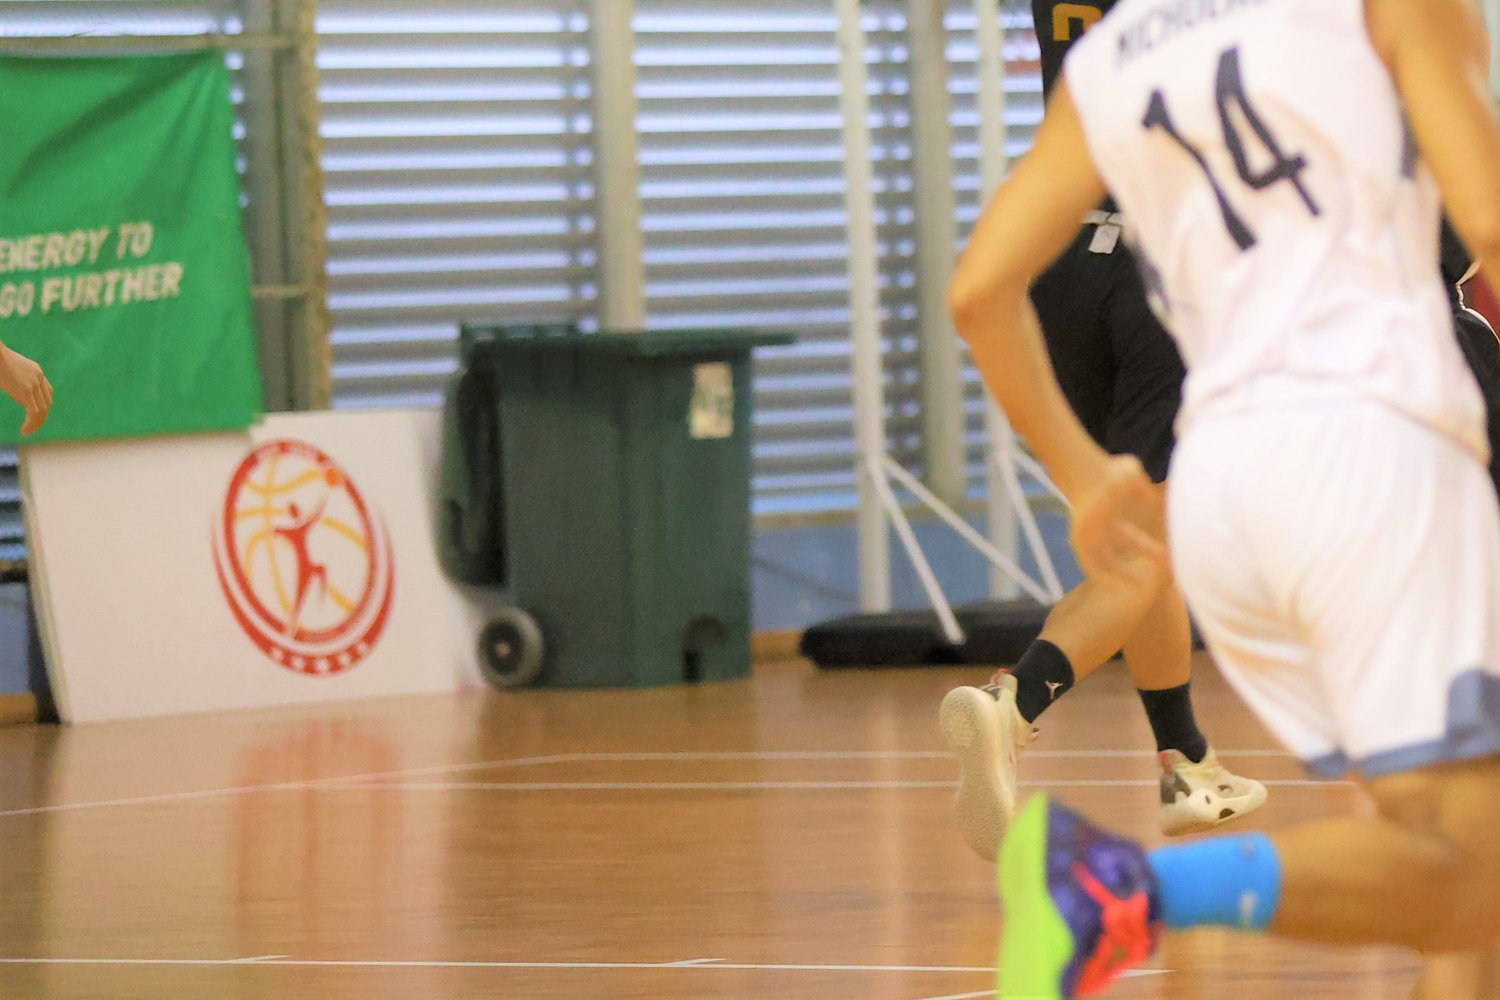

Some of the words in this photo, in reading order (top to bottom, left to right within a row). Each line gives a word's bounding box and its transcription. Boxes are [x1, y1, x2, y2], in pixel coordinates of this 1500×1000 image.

[1141, 42, 1322, 253] 14
[116, 221, 154, 260] TO
[41, 261, 184, 315] FURTHER
